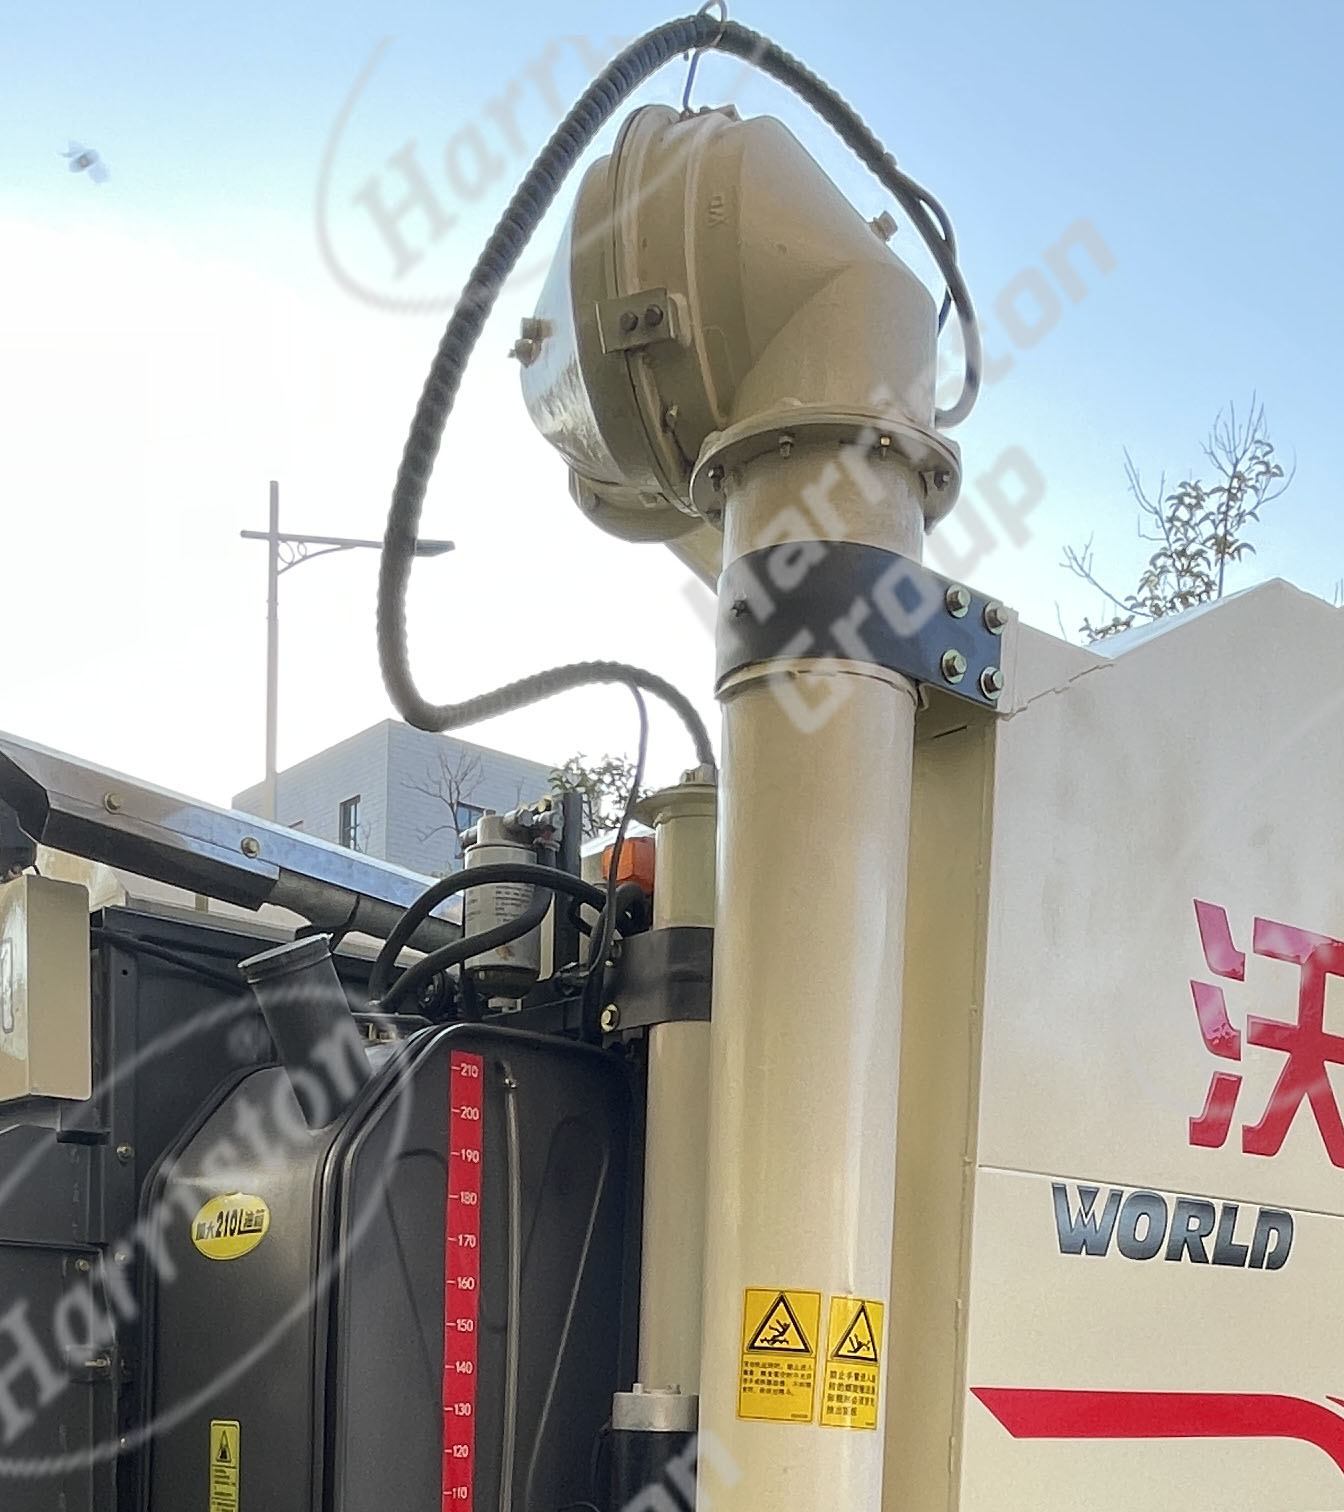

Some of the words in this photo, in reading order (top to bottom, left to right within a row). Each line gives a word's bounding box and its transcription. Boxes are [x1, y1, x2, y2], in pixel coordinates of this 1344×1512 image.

[459, 1063, 479, 1078] 210
[459, 1106, 480, 1121] 200
[460, 1148, 480, 1164] 190
[1051, 1182, 1295, 1271] WORLD
[457, 1234, 476, 1248] 170
[457, 1276, 475, 1290] 160
[455, 1318, 474, 1332] 150
[454, 1360, 473, 1375] 140
[453, 1402, 472, 1417] 130
